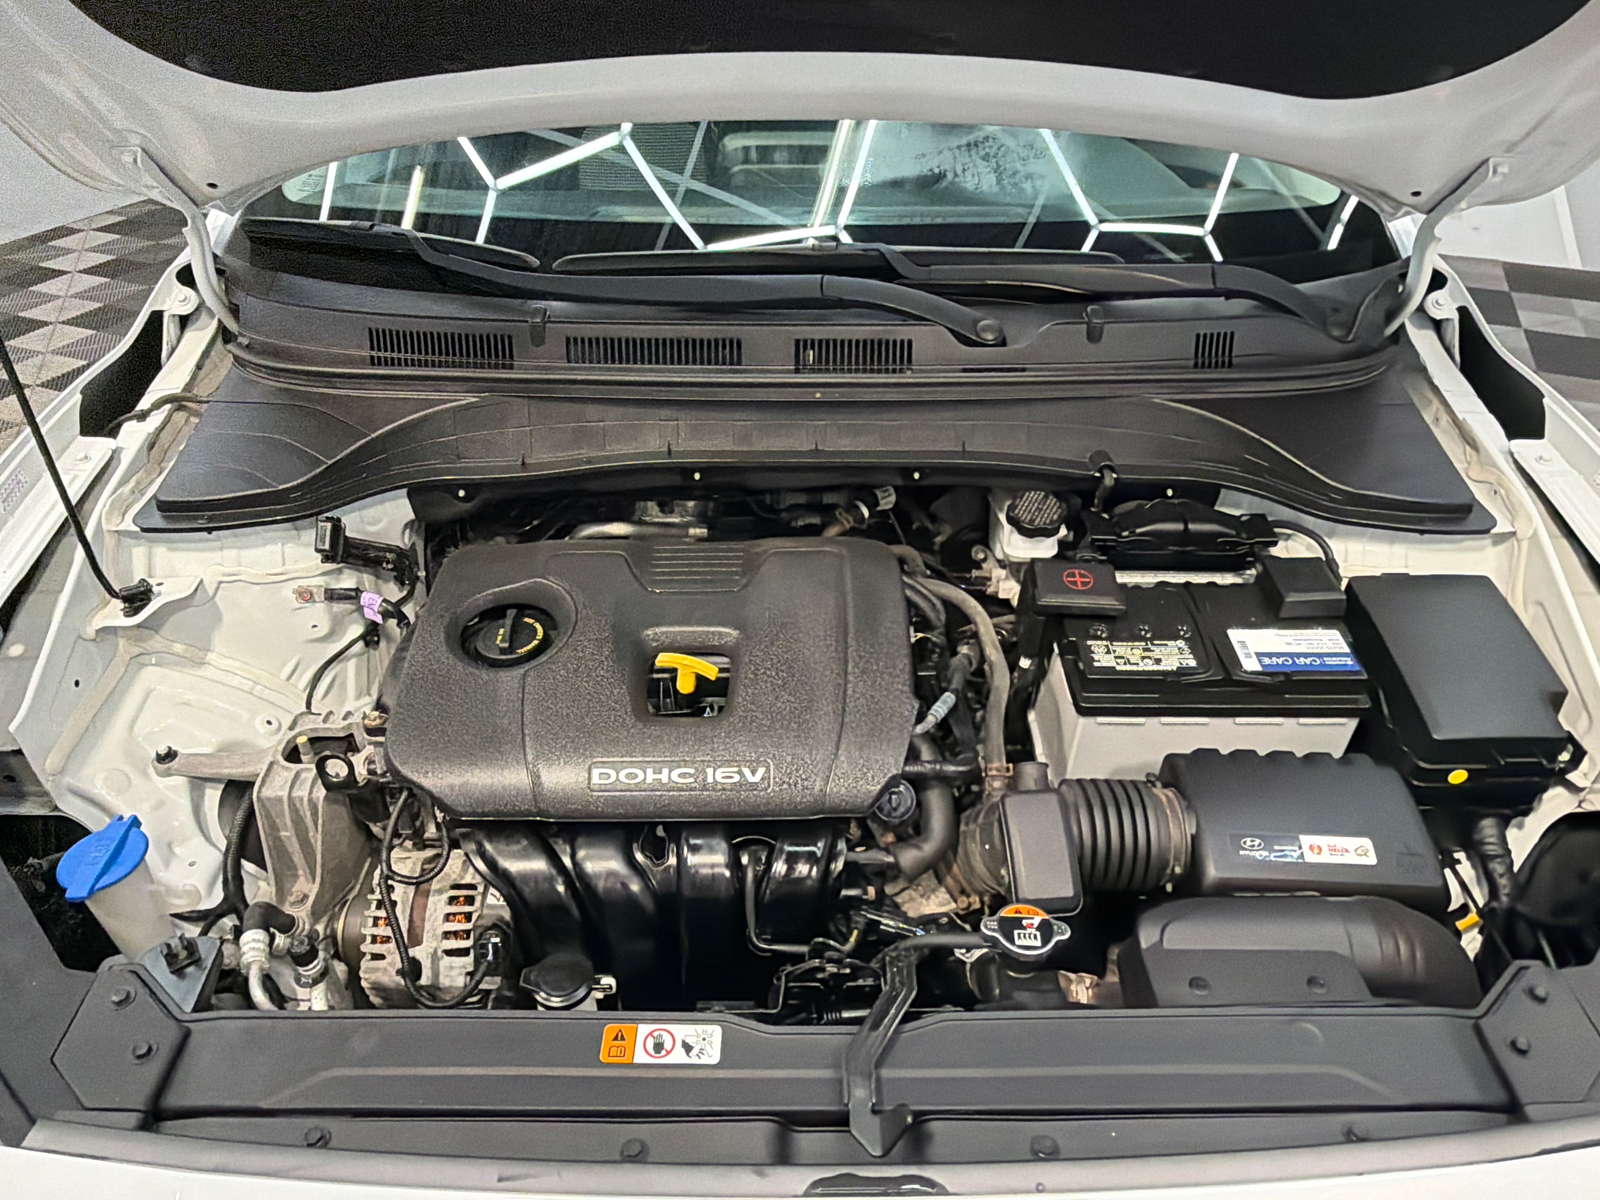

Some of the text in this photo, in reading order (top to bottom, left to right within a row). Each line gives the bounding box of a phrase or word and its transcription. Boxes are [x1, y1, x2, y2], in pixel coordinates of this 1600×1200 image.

[1259, 656, 1292, 666] CARE
[1294, 656, 1320, 666] CAR
[592, 767, 767, 784] DOHC 16V
